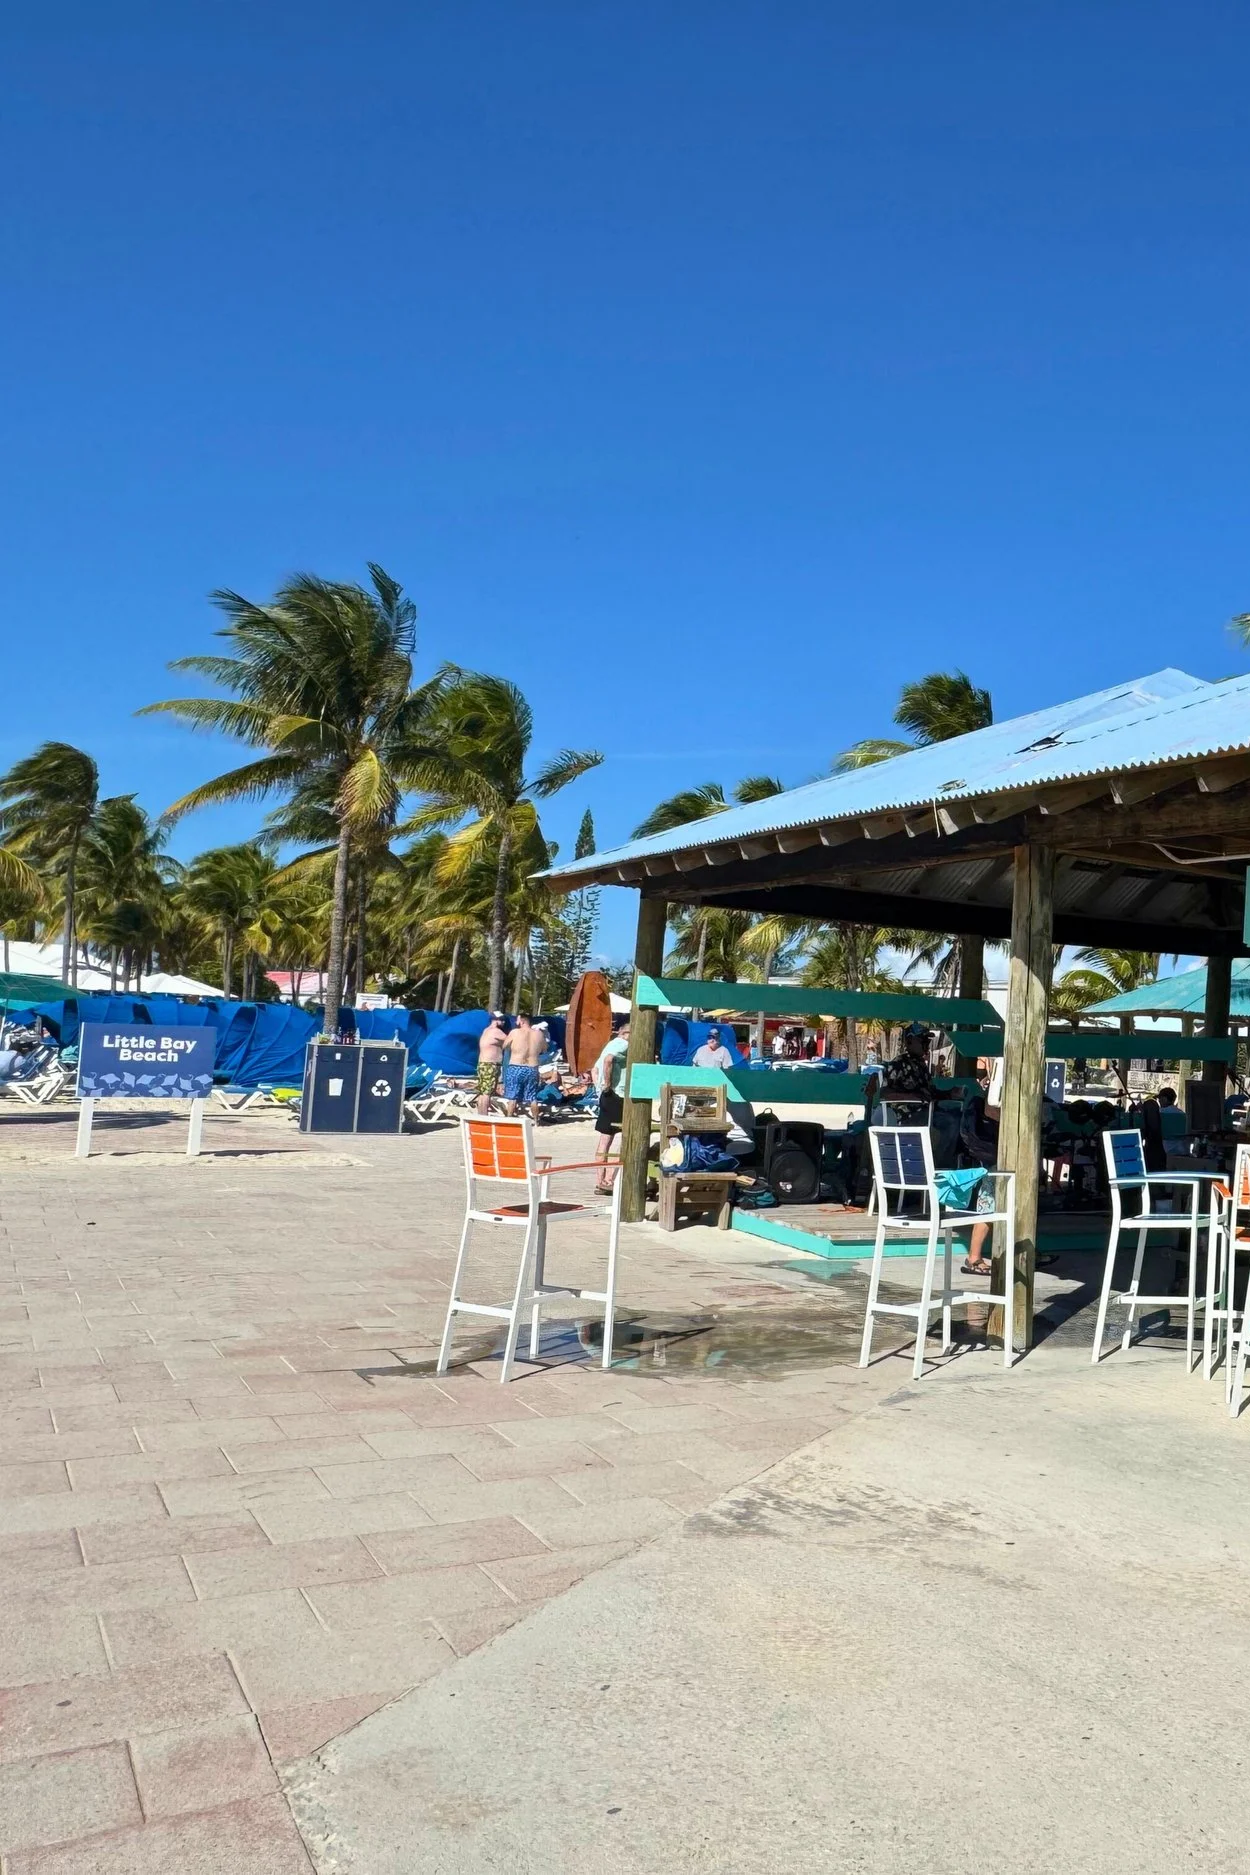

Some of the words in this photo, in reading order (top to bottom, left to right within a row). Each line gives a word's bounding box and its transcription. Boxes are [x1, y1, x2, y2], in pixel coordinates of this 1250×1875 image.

[103, 1034, 157, 1049] Little
[160, 1037, 198, 1054] Bay
[119, 1048, 179, 1062] Beach
